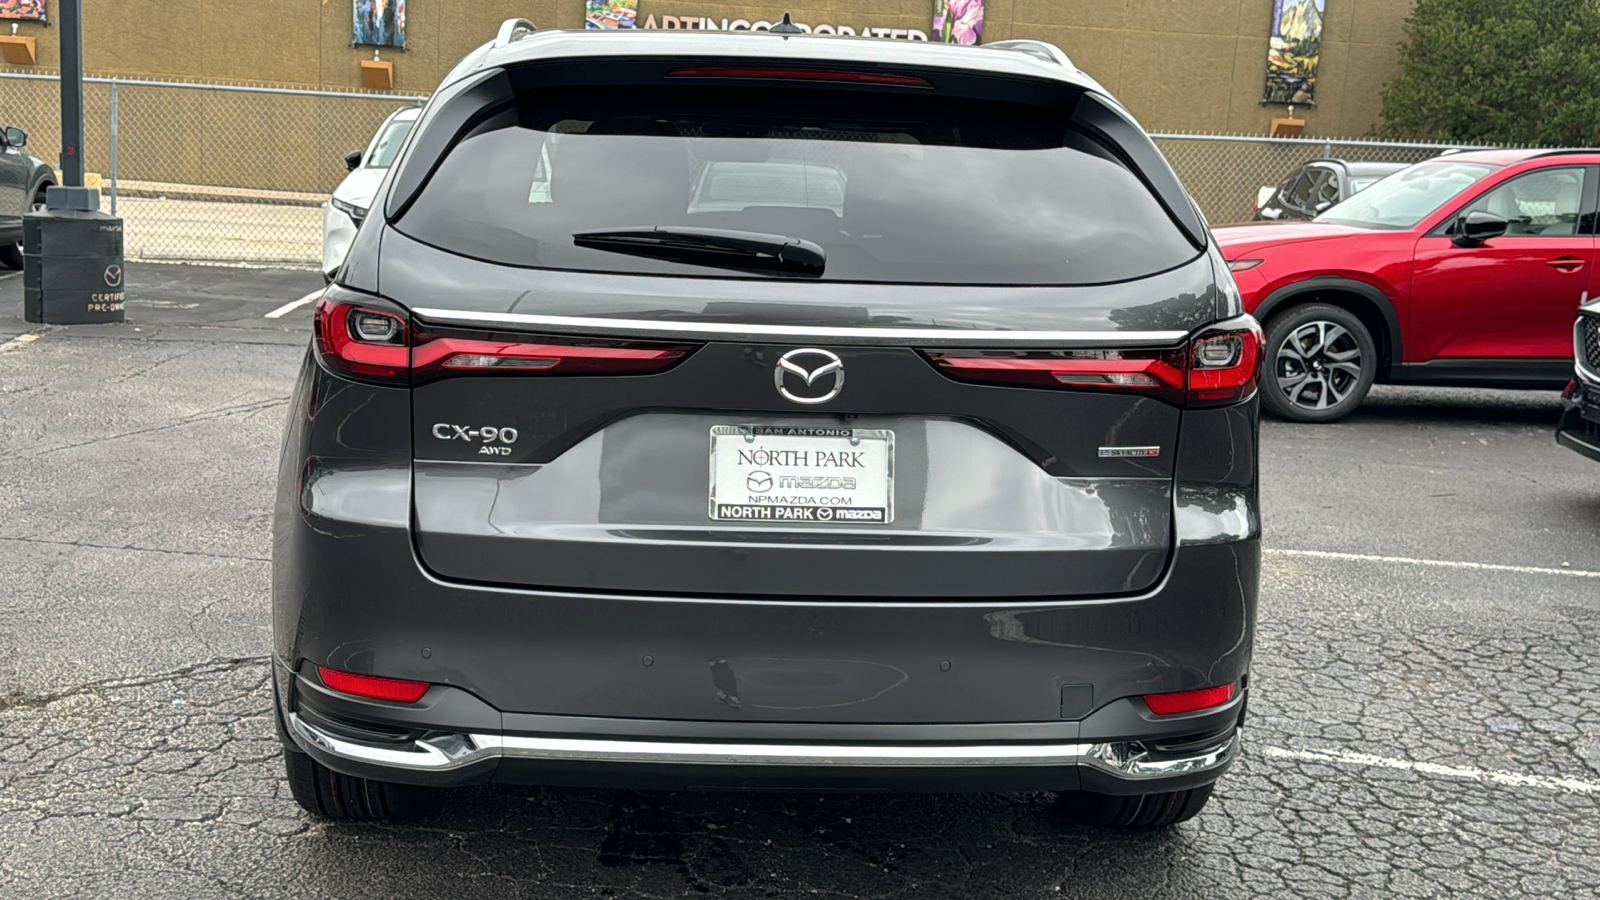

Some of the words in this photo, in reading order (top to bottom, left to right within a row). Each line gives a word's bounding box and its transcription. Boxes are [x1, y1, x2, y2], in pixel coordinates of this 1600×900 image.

[432, 423, 518, 444] CX-90
[754, 427, 785, 436] SAN
[788, 428, 850, 437] ANTONIO
[478, 445, 512, 456] AWD
[737, 448, 809, 467] NORTH
[815, 451, 866, 468] PARK
[748, 494, 853, 506] NPMAZDA.COM
[720, 505, 772, 520] NORTH
[775, 507, 814, 520] PARK
